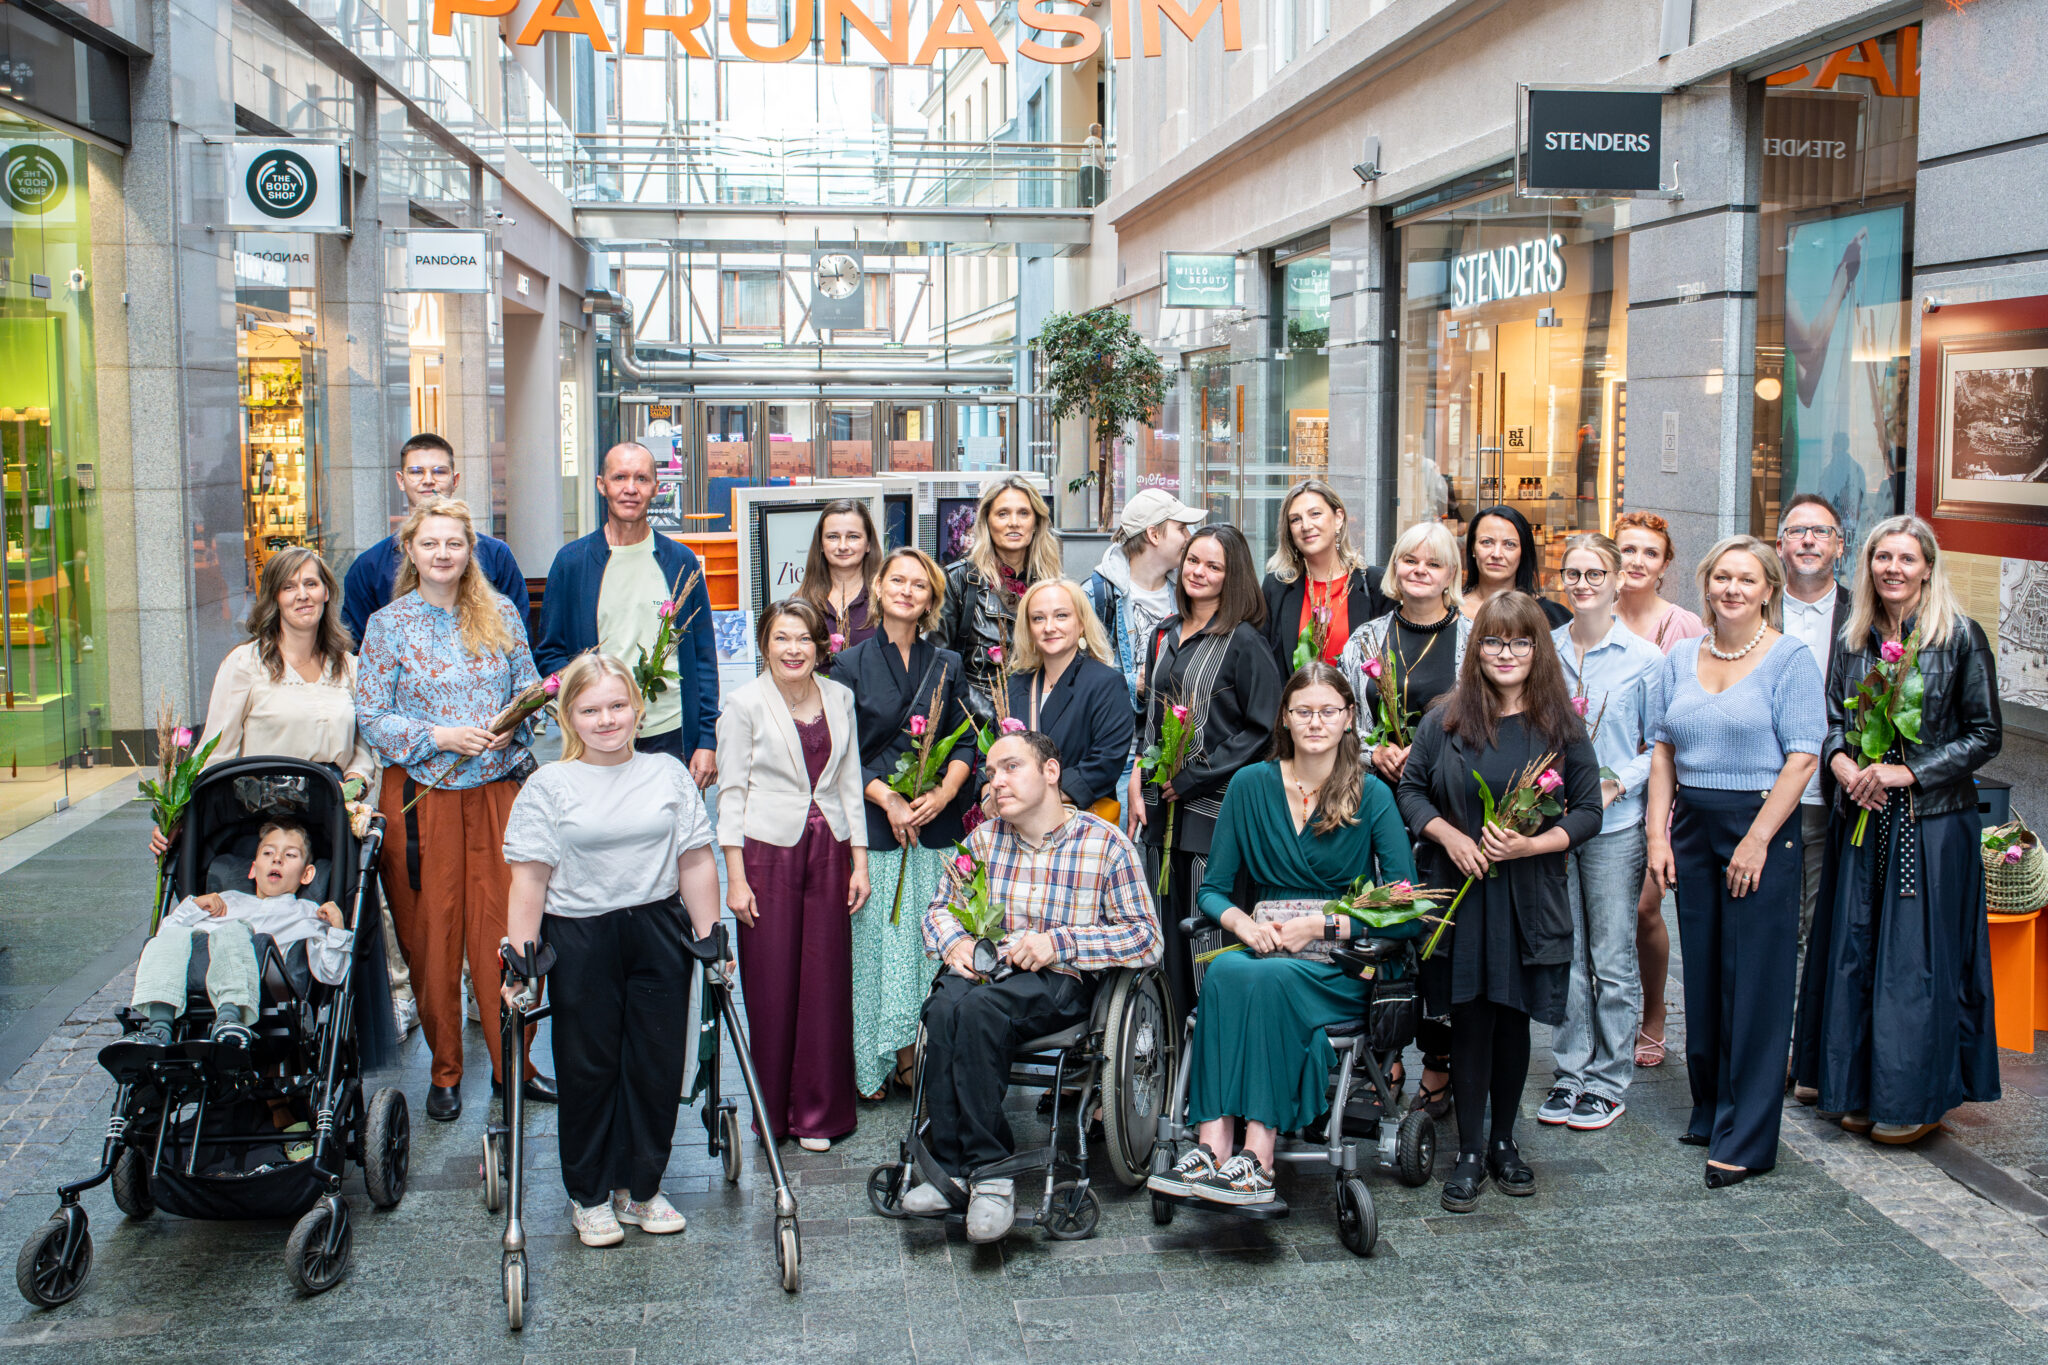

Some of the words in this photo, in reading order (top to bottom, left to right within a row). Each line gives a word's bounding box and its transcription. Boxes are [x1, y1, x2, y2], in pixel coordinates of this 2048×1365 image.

[1545, 131, 1650, 152] STENDERS
[272, 174, 291, 182] THE
[265, 182, 297, 191] BODY
[268, 191, 296, 200] SHOP
[415, 254, 478, 266] PANDORA
[1175, 267, 1209, 276] MILLO
[1454, 233, 1564, 308] STENDERS
[1188, 276, 1228, 285] BEAUTY
[562, 384, 574, 476] ARKET
[1508, 438, 1525, 447] GA
